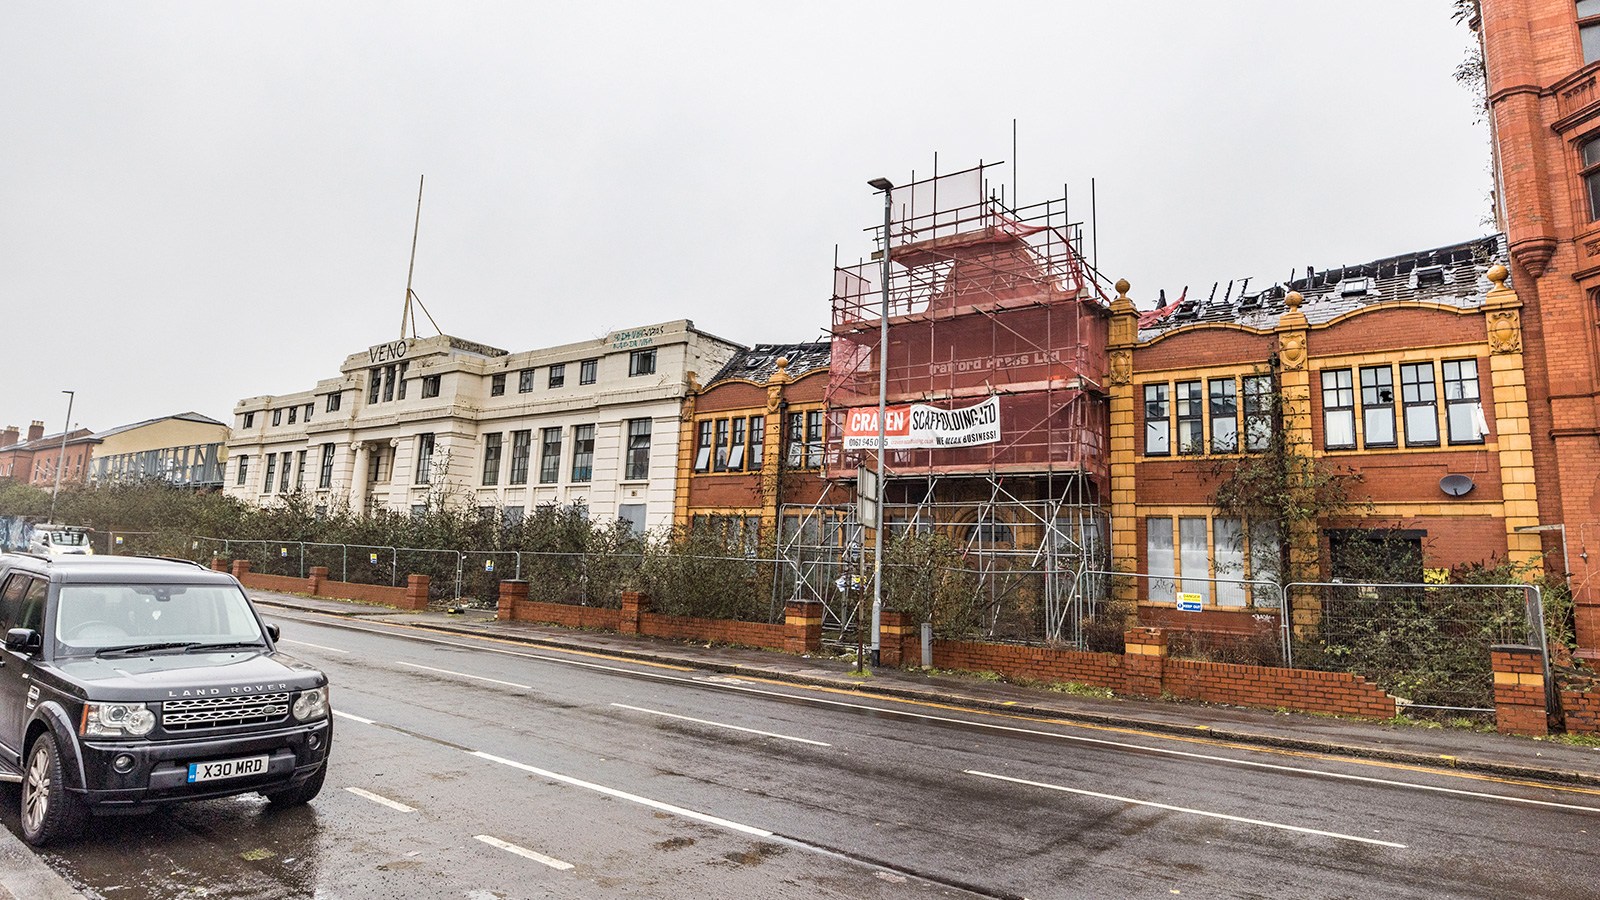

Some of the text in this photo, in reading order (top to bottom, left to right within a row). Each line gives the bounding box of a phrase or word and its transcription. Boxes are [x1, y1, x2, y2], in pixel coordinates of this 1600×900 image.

[369, 341, 406, 363] VENO
[1034, 351, 1060, 364] Ltd
[851, 403, 996, 432] CRAEN SCAFFOLDING LTD
[962, 430, 997, 443] BUSINESS!
[168, 683, 287, 698] LAND ROVER
[203, 759, 262, 778] X30 MRD
